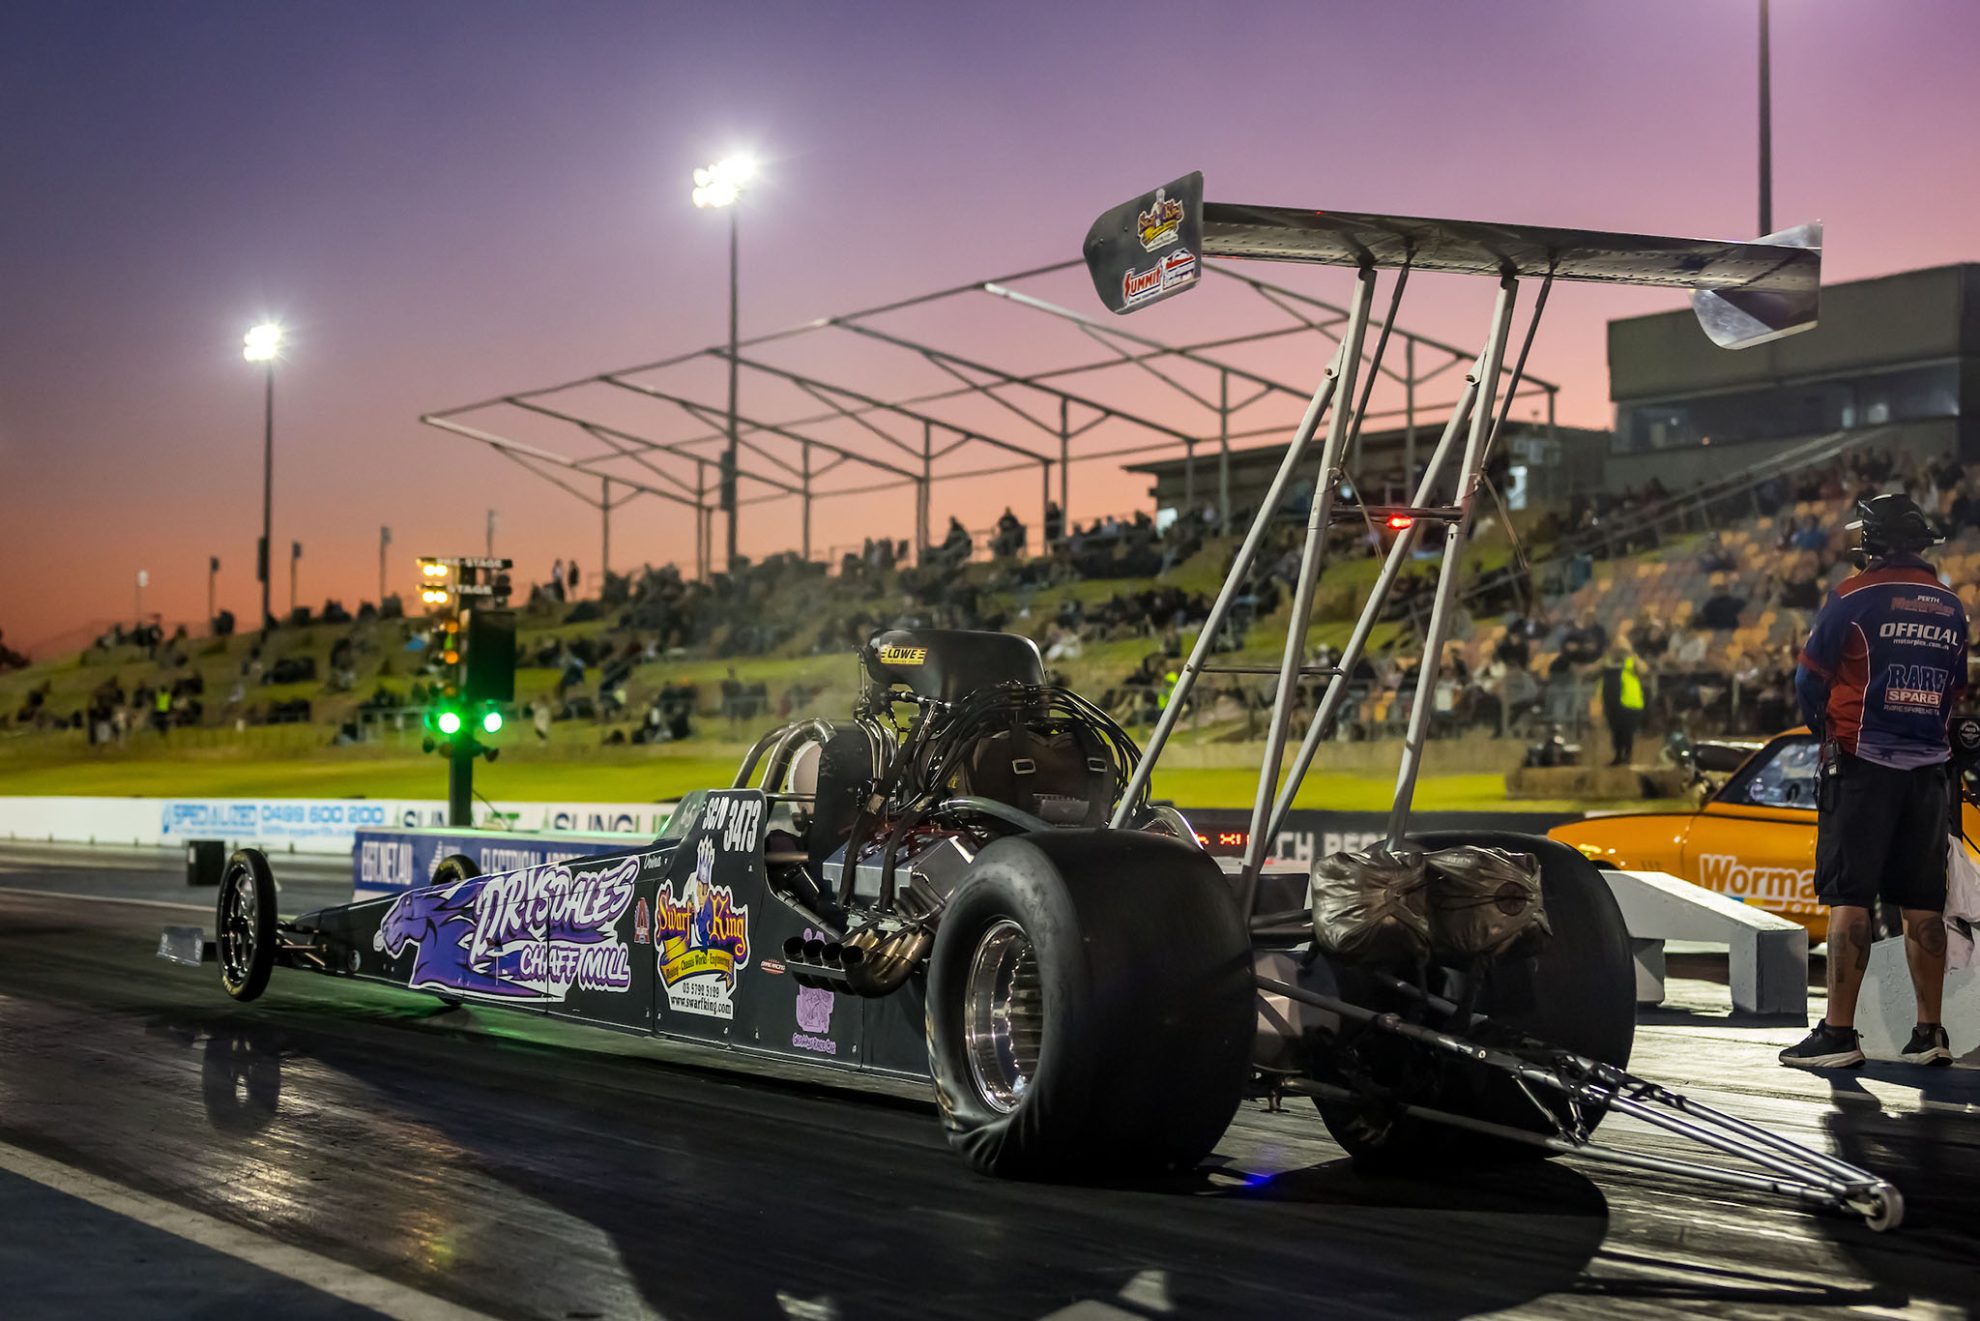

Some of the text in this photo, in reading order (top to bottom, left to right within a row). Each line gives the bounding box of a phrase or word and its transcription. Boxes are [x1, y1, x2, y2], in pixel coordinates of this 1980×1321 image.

[1124, 265, 1163, 300] SUMMIT
[446, 584, 493, 595] STAGE
[1917, 594, 1941, 604] PERTH
[1879, 621, 1959, 647] OFFICIAL
[887, 648, 918, 660] LOWE
[1887, 663, 1949, 694] RARE
[723, 799, 762, 853] 3473
[469, 858, 639, 966] DRYSDALES
[657, 893, 747, 957] Swarf King
[520, 946, 580, 980] CHAFF
[581, 948, 631, 983] MILL
[670, 996, 732, 1015] www.swarfking.com
